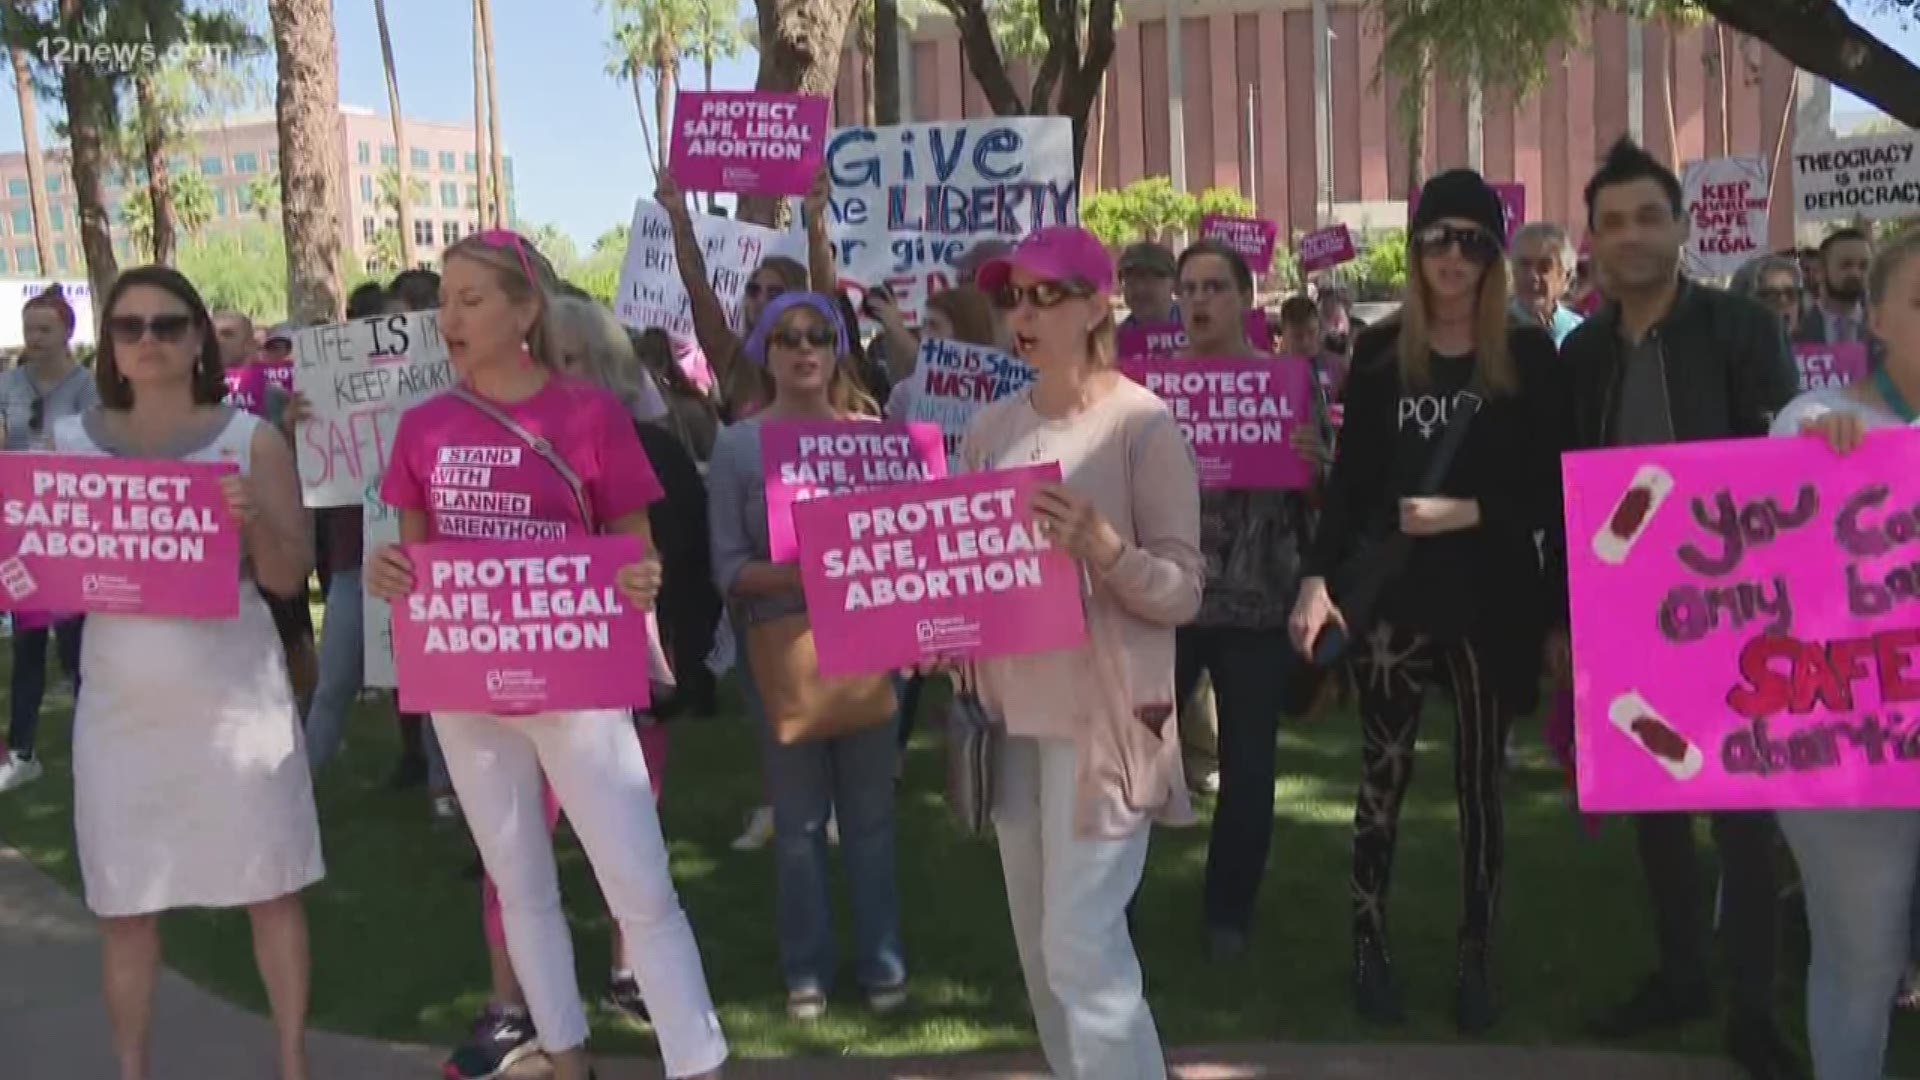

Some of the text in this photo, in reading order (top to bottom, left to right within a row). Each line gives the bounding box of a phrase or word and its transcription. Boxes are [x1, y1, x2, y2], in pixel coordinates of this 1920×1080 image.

[701, 101, 797, 120] PROTECT
[683, 120, 811, 141] SAFE, LEGAL
[687, 138, 801, 160] ABORTION
[1796, 143, 1914, 174] THEOCRACY
[1702, 181, 1750, 199] KEEP
[1858, 168, 1895, 183] NOT
[887, 180, 1075, 236] LIBERTY
[1804, 181, 1920, 211] DEMOCRACY
[1697, 211, 1748, 228] SAFE
[892, 238, 964, 272] give
[1700, 237, 1756, 254] LEGAL
[300, 326, 353, 367] LIFE
[365, 314, 410, 357] IS
[1146, 332, 1190, 350] PRO
[334, 370, 390, 408] KEEP
[1145, 370, 1270, 395] PROTECT
[1208, 396, 1294, 420] LEGAL
[800, 433, 909, 458] PROTECT
[1179, 421, 1282, 445] ORTION
[449, 449, 512, 464] STAND
[33, 471, 191, 502] PROTECT
[780, 461, 934, 485] SAFE, LEGAL
[432, 490, 526, 513] PLANNED
[848, 488, 1015, 540] PROTECT
[4, 501, 219, 534] SAFE, LEGAL
[18, 530, 204, 562] ABORTION
[822, 519, 1051, 578] SAFE, LEGAL
[432, 554, 591, 589] PROTECT
[844, 556, 1042, 611] ABORTION
[408, 587, 622, 623] SAFE, LEGAL
[424, 621, 609, 655] ABORTION
[1725, 628, 1920, 718] SAFE
